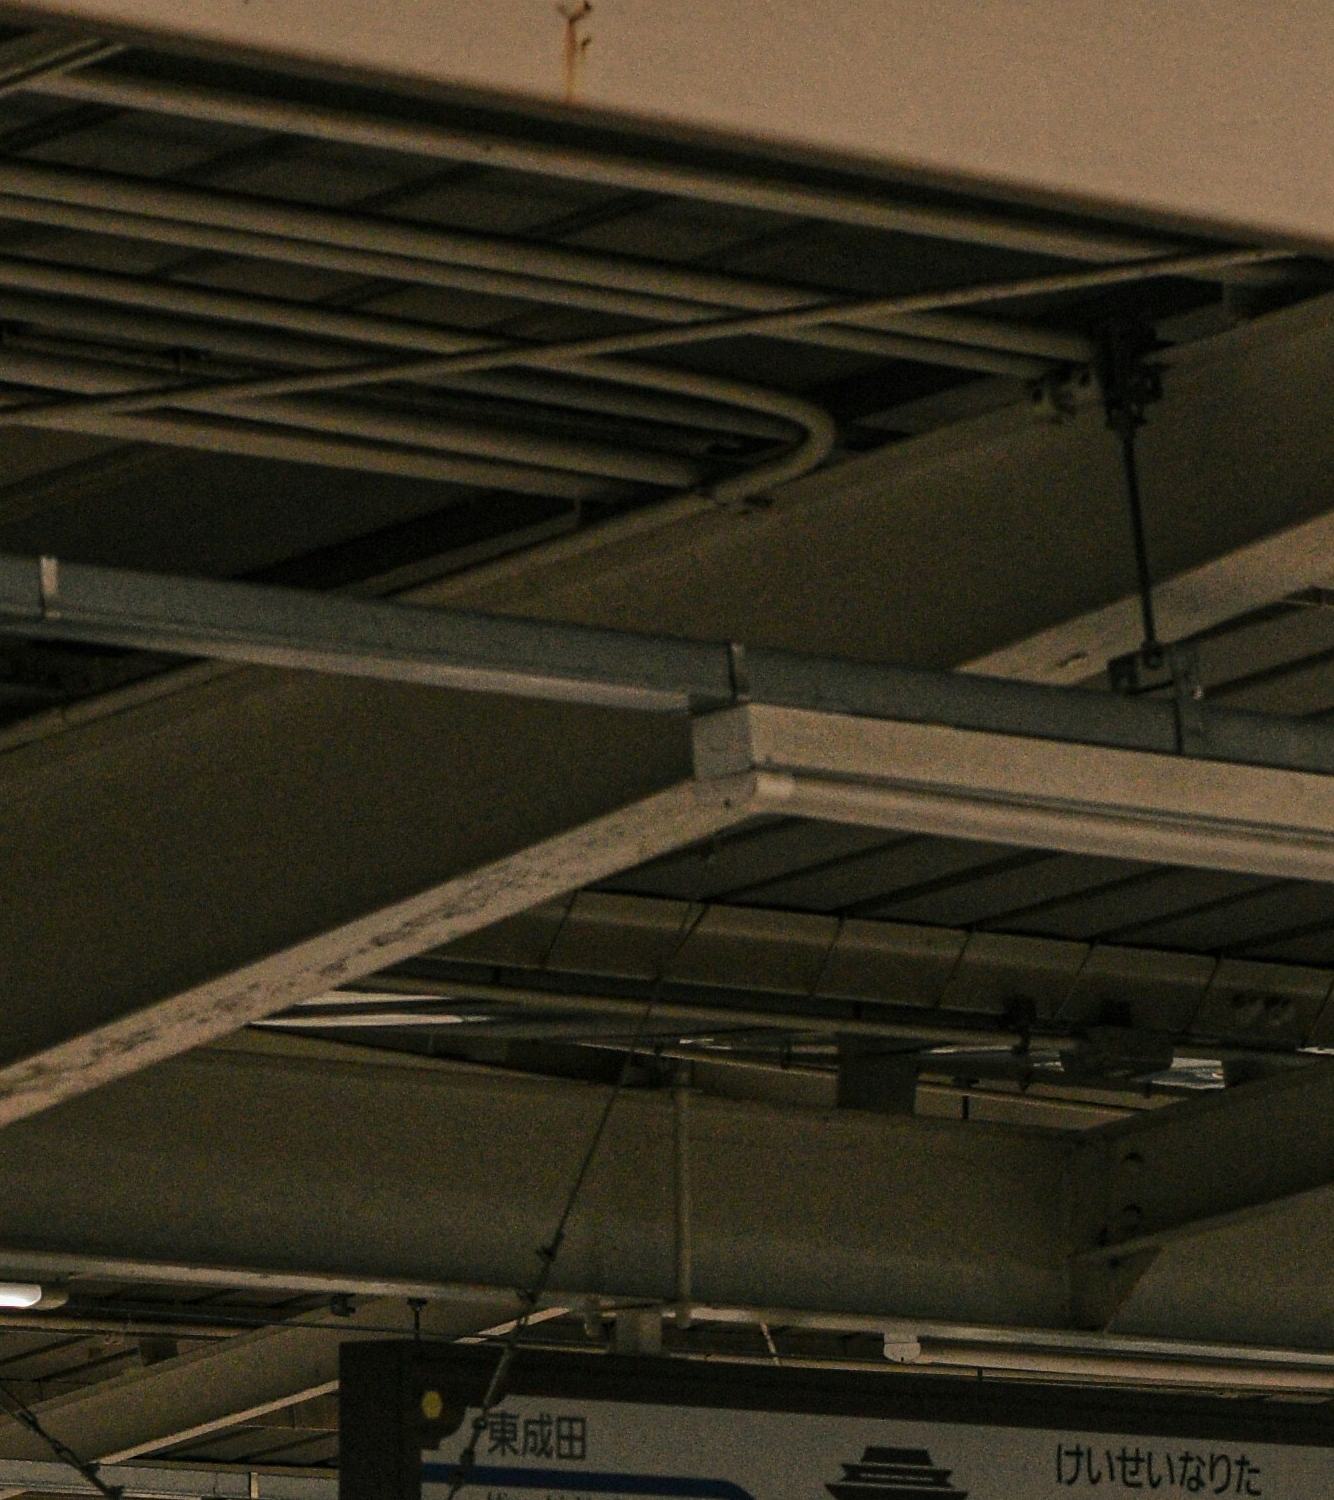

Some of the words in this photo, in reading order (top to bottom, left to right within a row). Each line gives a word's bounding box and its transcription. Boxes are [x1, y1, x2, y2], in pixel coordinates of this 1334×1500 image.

[486, 1411, 587, 1461] 東成田
[1056, 1442, 1262, 1497] けいせいなりた
